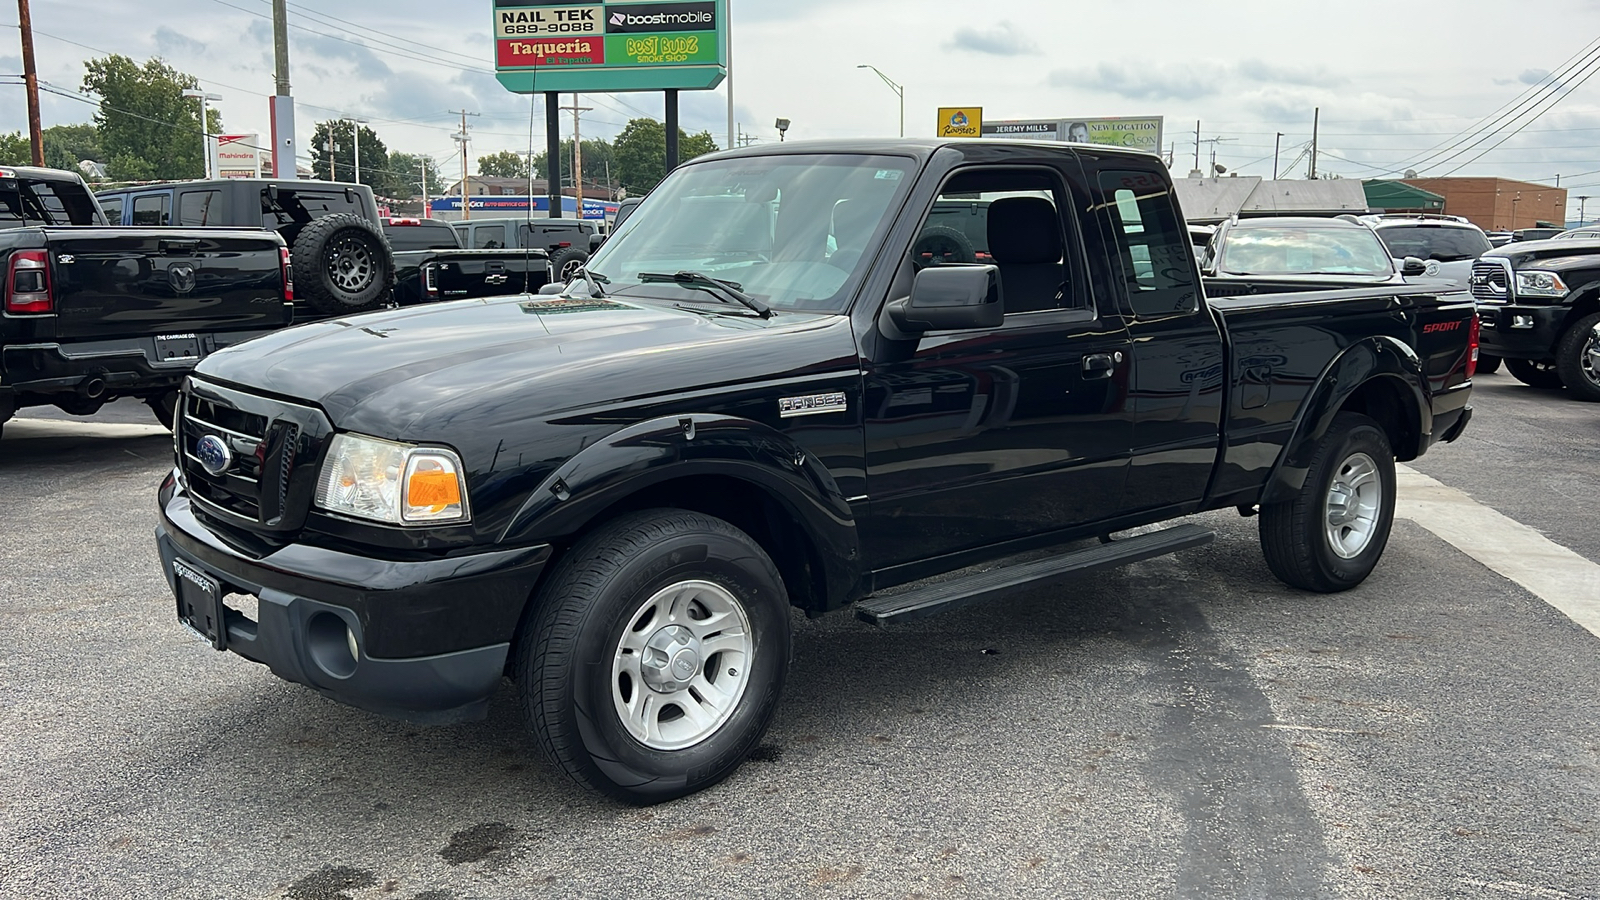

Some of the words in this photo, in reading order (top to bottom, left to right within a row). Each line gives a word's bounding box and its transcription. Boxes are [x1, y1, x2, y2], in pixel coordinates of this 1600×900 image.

[502, 11, 546, 23] NAIL
[554, 9, 594, 21] TEK
[505, 22, 594, 34] 689-9088
[637, 54, 665, 63] SMOKE
[665, 54, 688, 62] SHOP
[942, 124, 977, 137] Roosters
[996, 125, 1025, 133] JEREMY
[1026, 124, 1049, 132] MILLS
[1112, 123, 1157, 131] LOCATION
[1422, 320, 1462, 334] SPORT
[779, 391, 847, 411] RANGER
